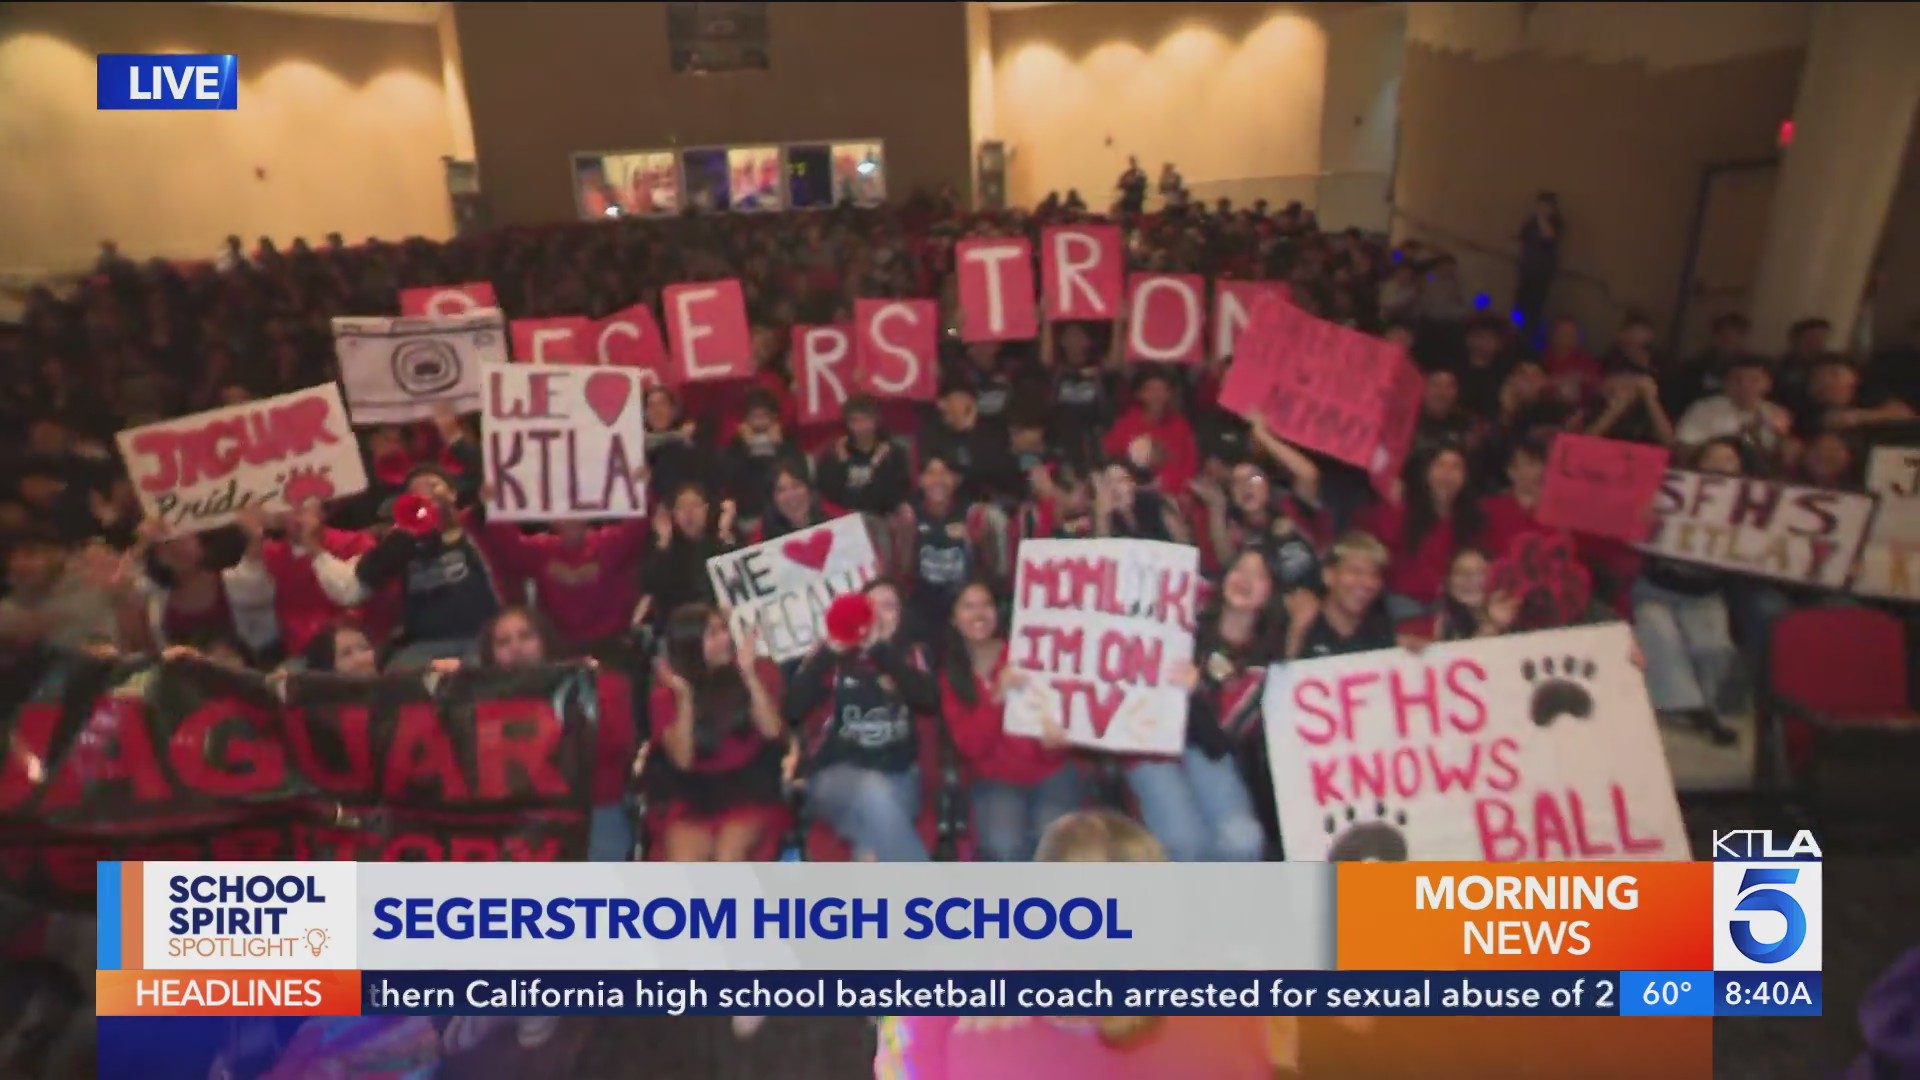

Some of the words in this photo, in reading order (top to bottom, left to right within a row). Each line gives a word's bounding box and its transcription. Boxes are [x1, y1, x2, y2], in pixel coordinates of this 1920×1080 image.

[490, 371, 571, 419] WE
[131, 396, 338, 493] JAGUAR
[490, 427, 642, 512] KTLA
[714, 549, 777, 606] WE
[1019, 625, 1083, 675] IM
[1098, 629, 1163, 687] ON
[1051, 679, 1126, 740] TV
[1293, 658, 1489, 745] SFHS
[1310, 738, 1520, 807] KNOWS
[1475, 784, 1666, 862] BALL
